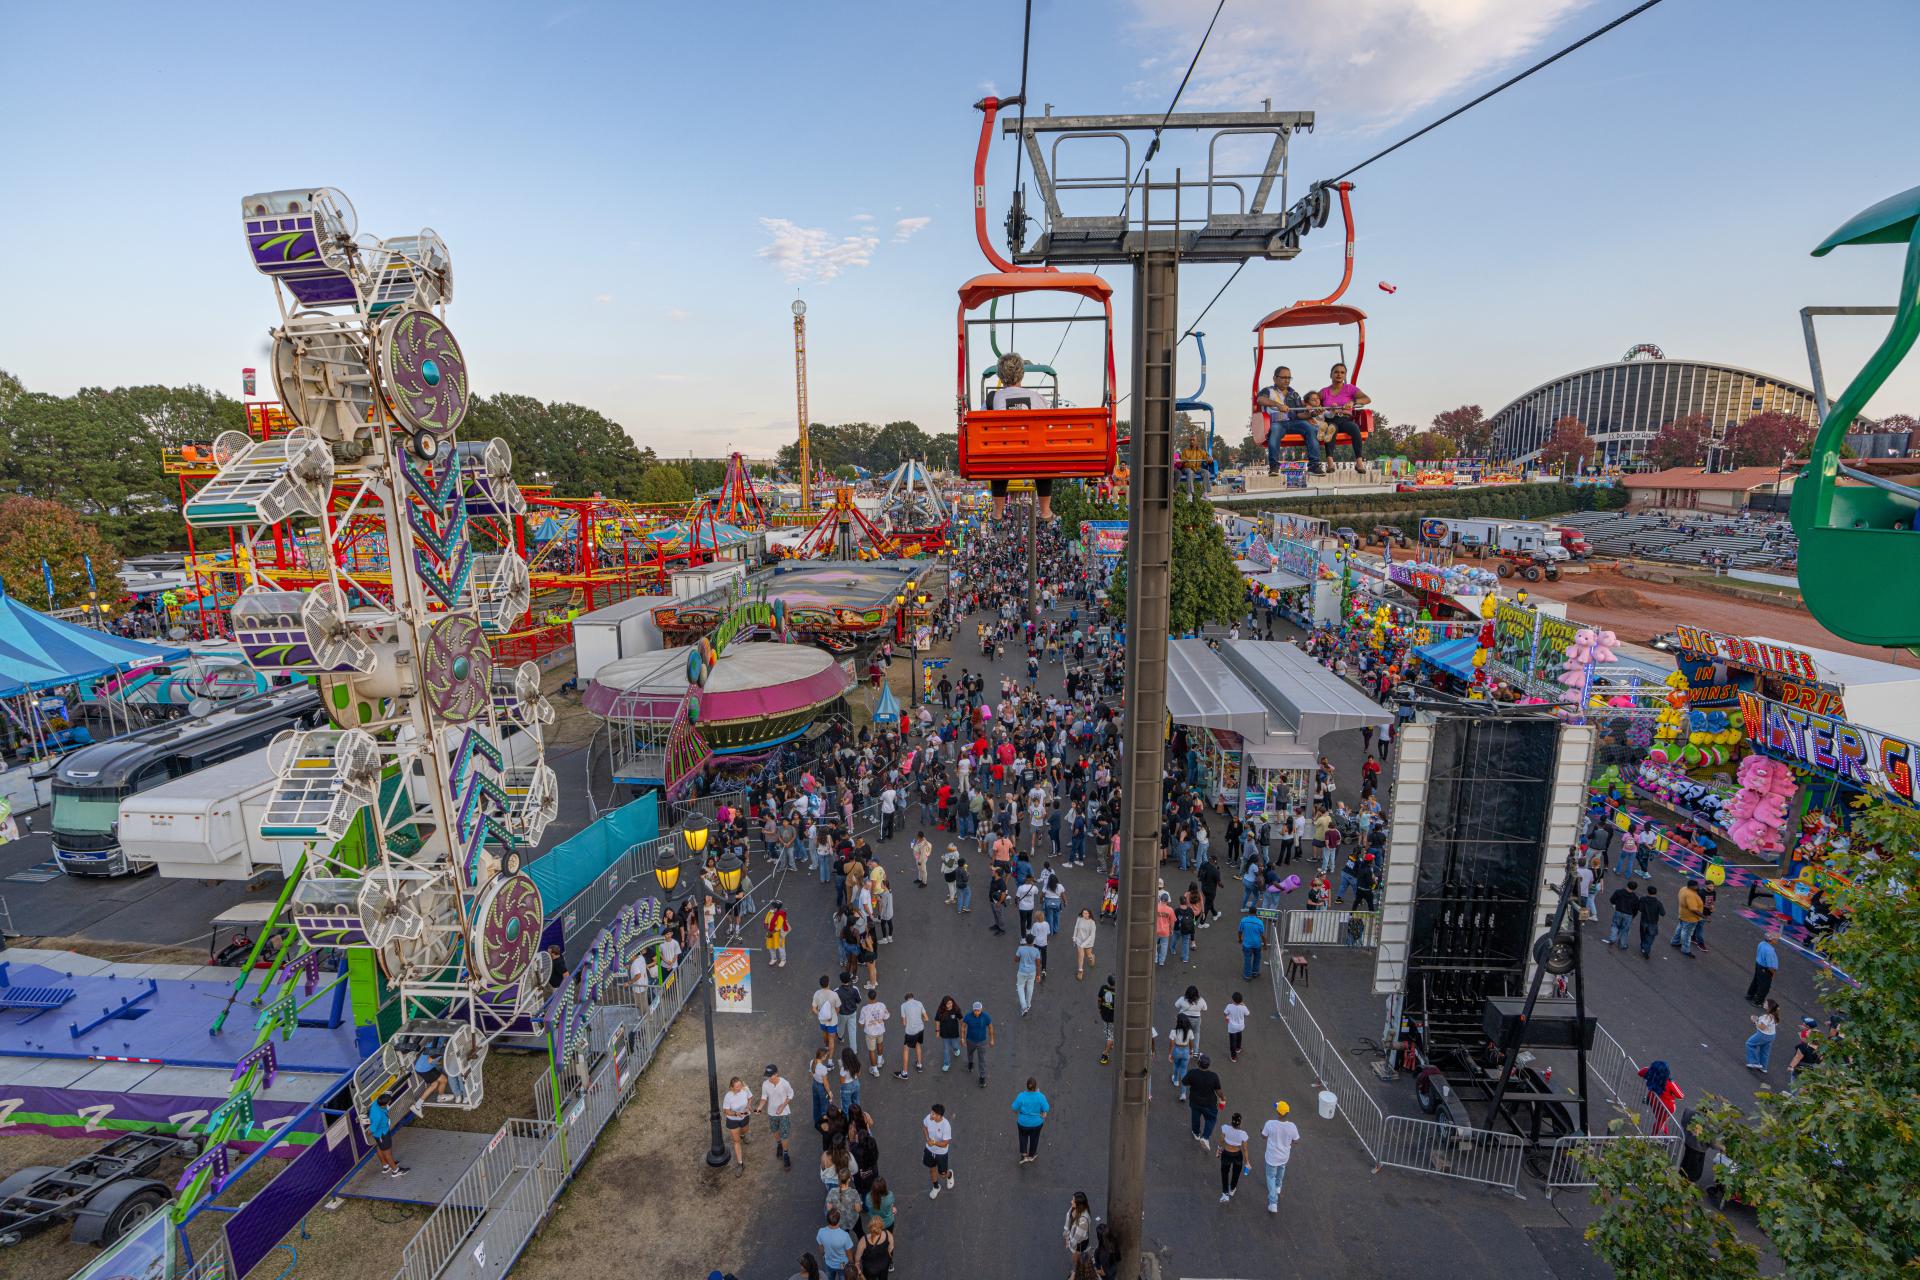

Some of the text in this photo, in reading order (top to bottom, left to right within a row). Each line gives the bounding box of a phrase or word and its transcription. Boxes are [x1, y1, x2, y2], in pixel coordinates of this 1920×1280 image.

[1499, 606, 1534, 633] FOOTBALL
[1506, 621, 1525, 640] TOSS
[1541, 621, 1577, 641] FOOTBA
[1550, 636, 1570, 654] TOS
[1675, 625, 1818, 682] BIG PRIZES
[1695, 665, 1715, 681] IN
[1688, 683, 1738, 702] WINS!
[1737, 690, 1920, 800] WATER G
